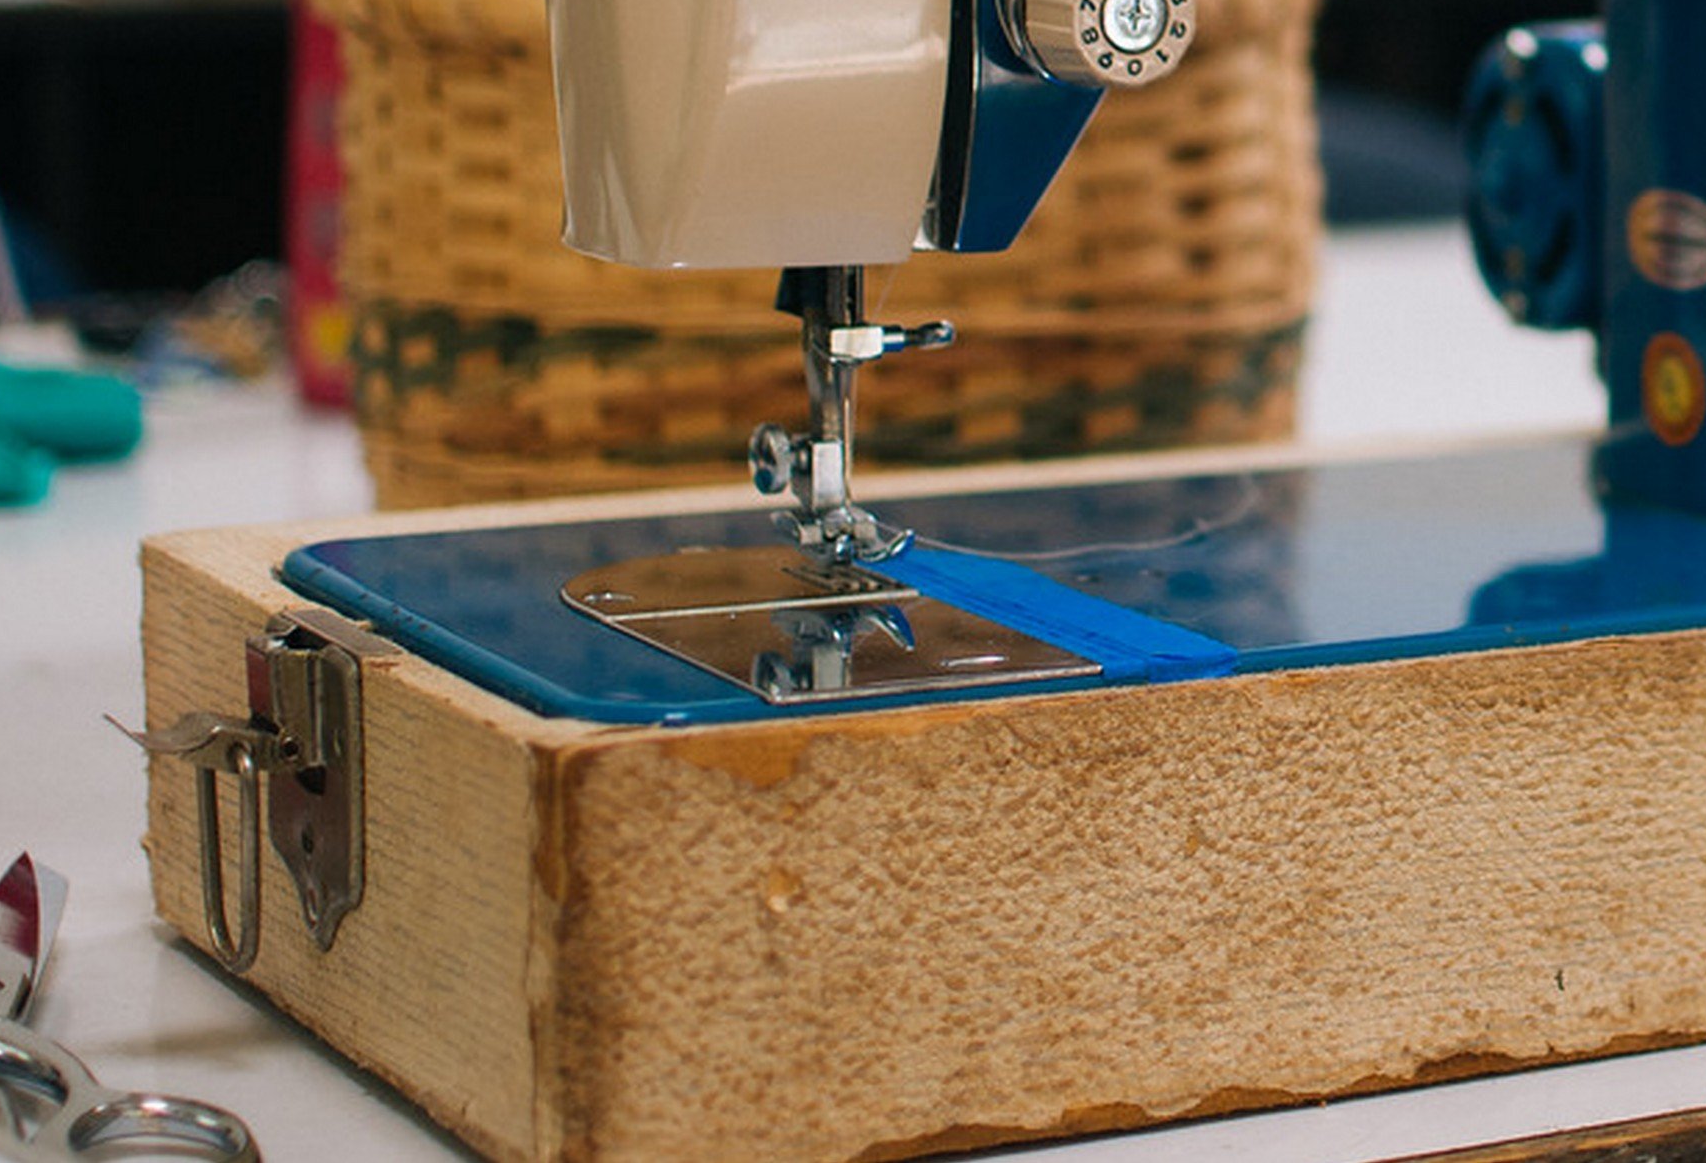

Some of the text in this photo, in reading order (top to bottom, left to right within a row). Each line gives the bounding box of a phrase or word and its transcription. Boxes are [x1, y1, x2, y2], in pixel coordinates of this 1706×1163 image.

[1081, 27, 1099, 45] 8
[1170, 20, 1186, 39] 2
[1155, 49, 1169, 63] 1
[1127, 58, 1142, 76] 0
